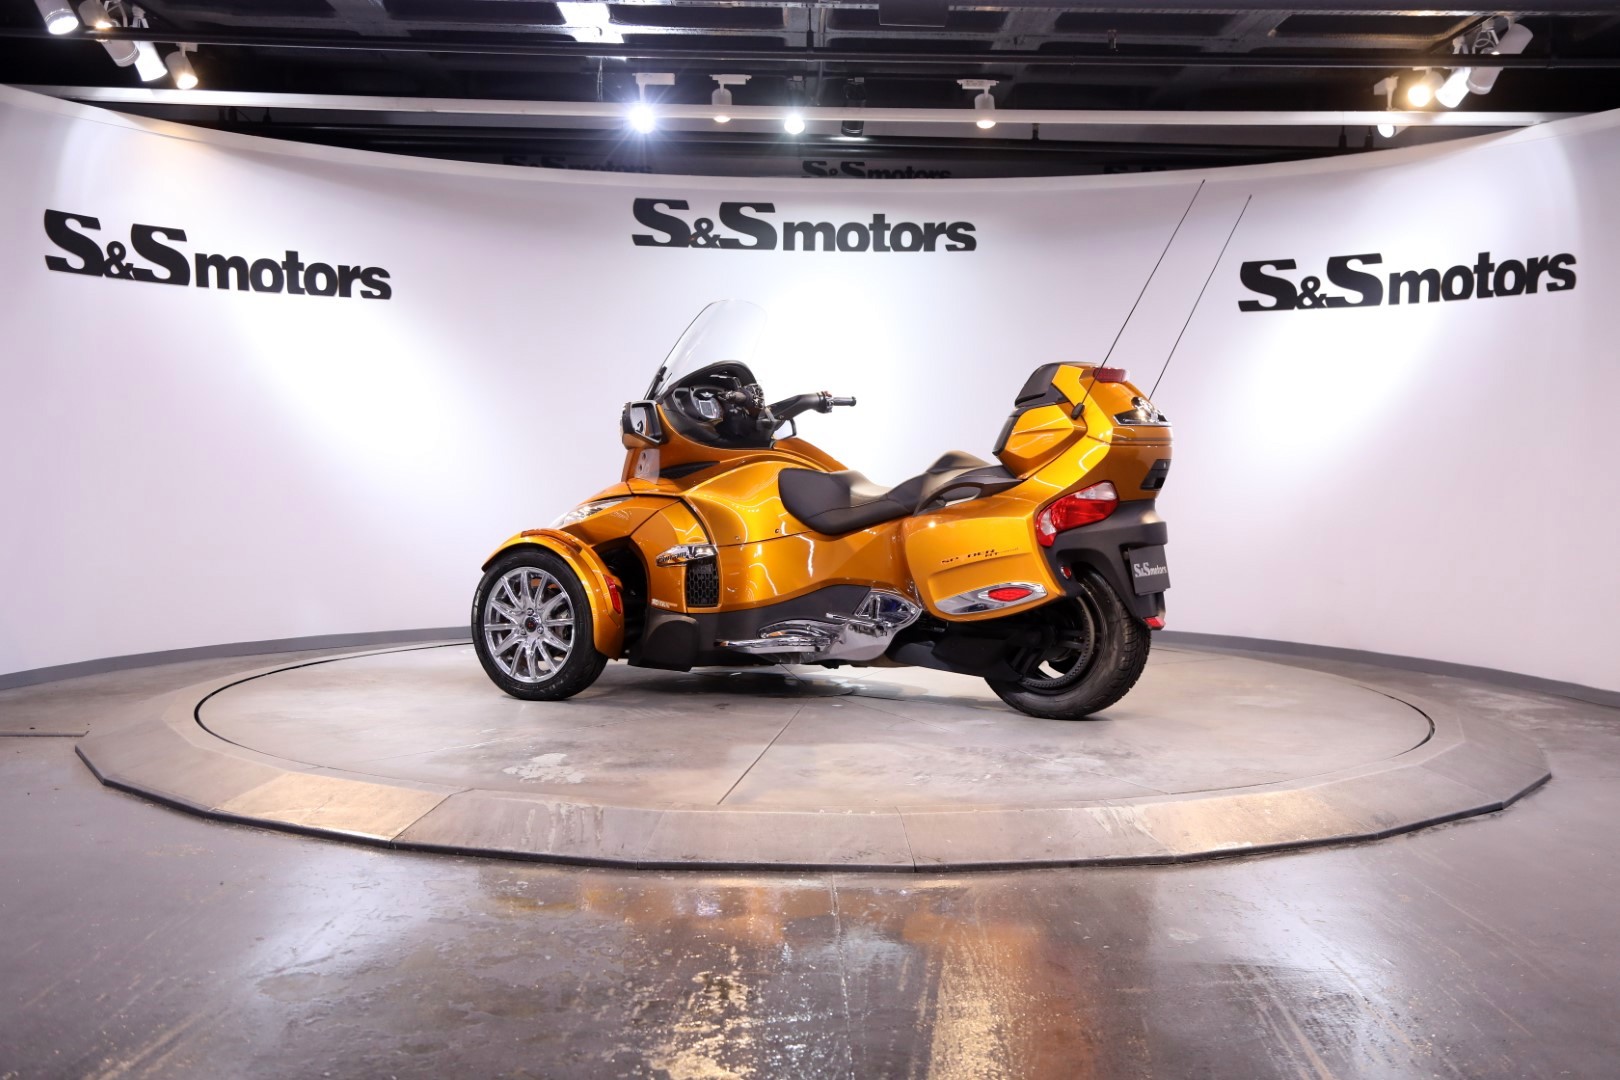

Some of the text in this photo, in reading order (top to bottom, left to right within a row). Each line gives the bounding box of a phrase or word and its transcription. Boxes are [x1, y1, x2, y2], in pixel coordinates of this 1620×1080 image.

[44, 209, 391, 299] S&S motors
[632, 198, 976, 251] S&S motors
[1238, 252, 1576, 312] S&S motors
